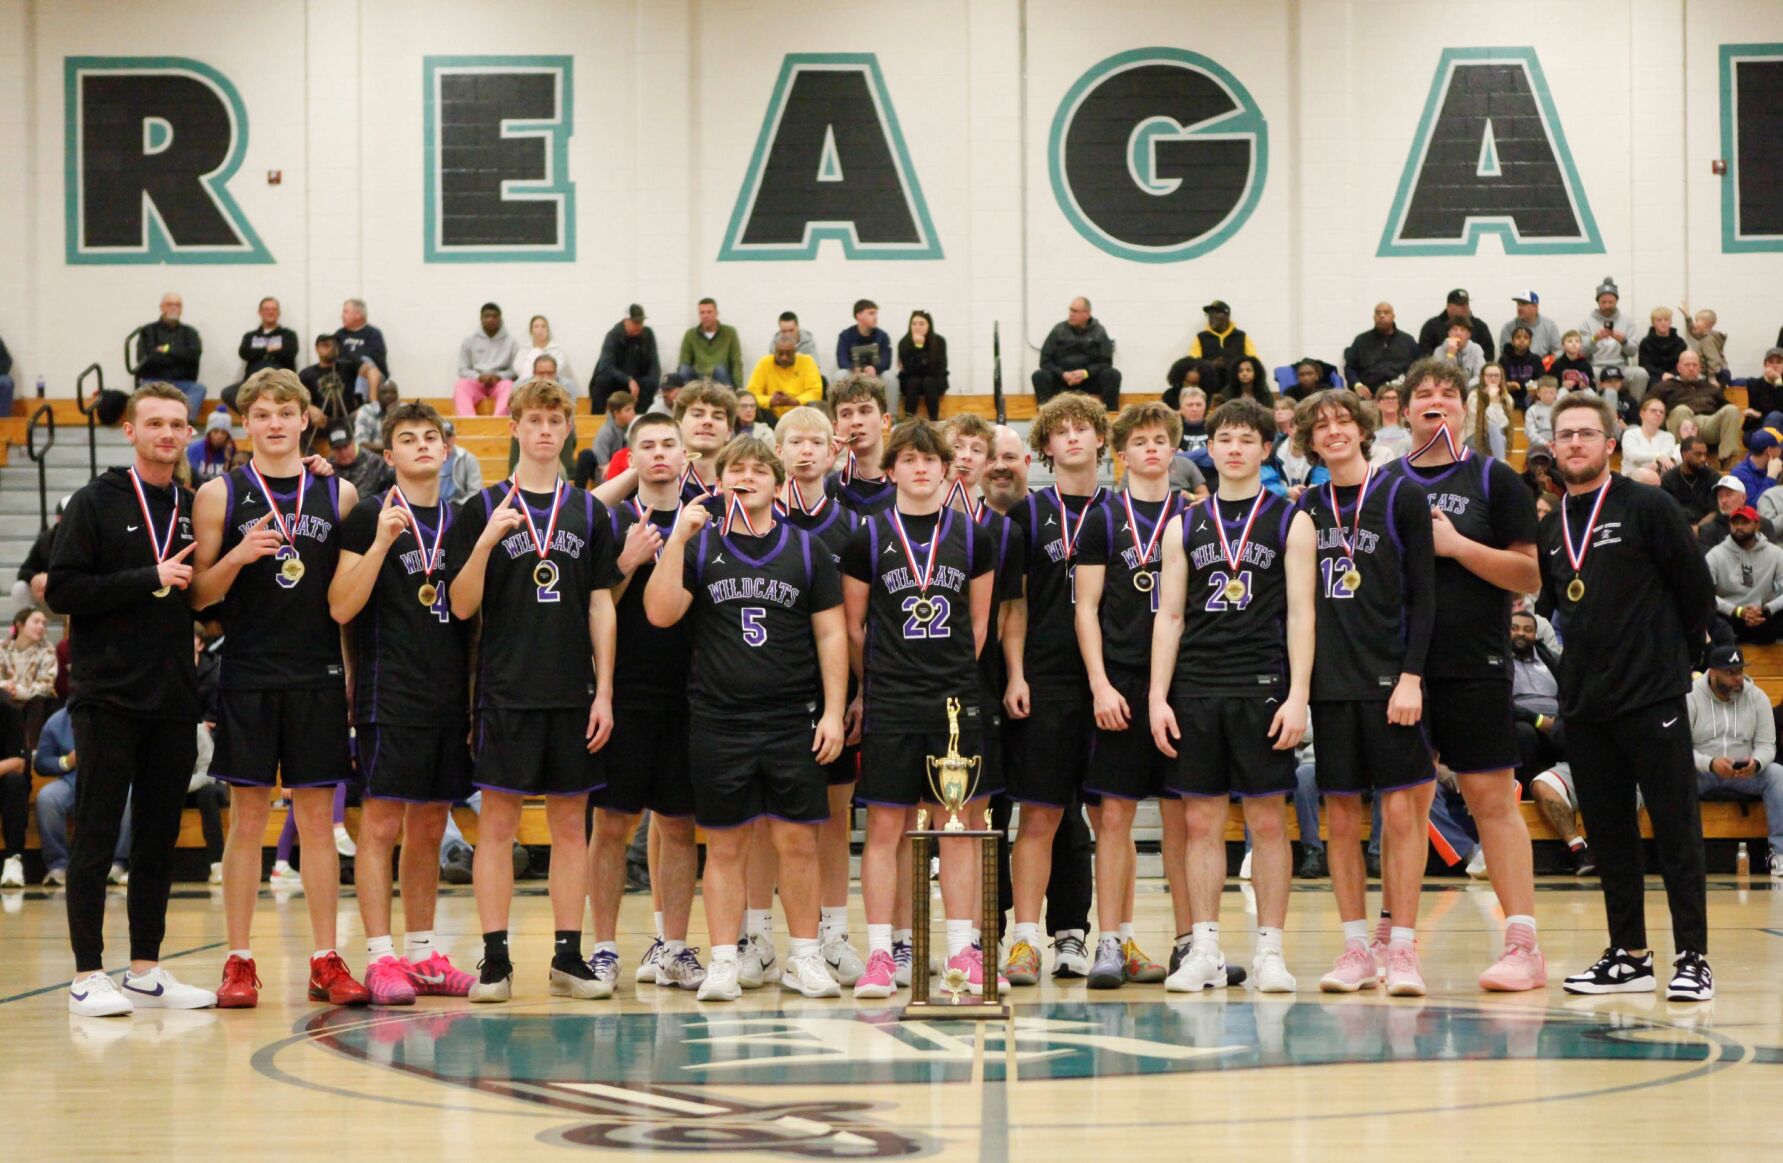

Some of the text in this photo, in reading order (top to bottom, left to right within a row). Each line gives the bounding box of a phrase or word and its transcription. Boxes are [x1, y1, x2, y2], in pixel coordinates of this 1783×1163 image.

[1427, 492, 1470, 515] CATS
[238, 513, 332, 543] WCATS
[502, 528, 585, 559] WILATS
[275, 545, 300, 589] 3
[536, 559, 560, 602] 2
[881, 565, 966, 594] WILATS
[1320, 556, 1357, 598] 12
[430, 579, 449, 622] 4
[707, 577, 800, 608] WILDCATS
[1205, 570, 1254, 611] 24
[741, 607, 768, 646] 5
[902, 595, 951, 639] 22
